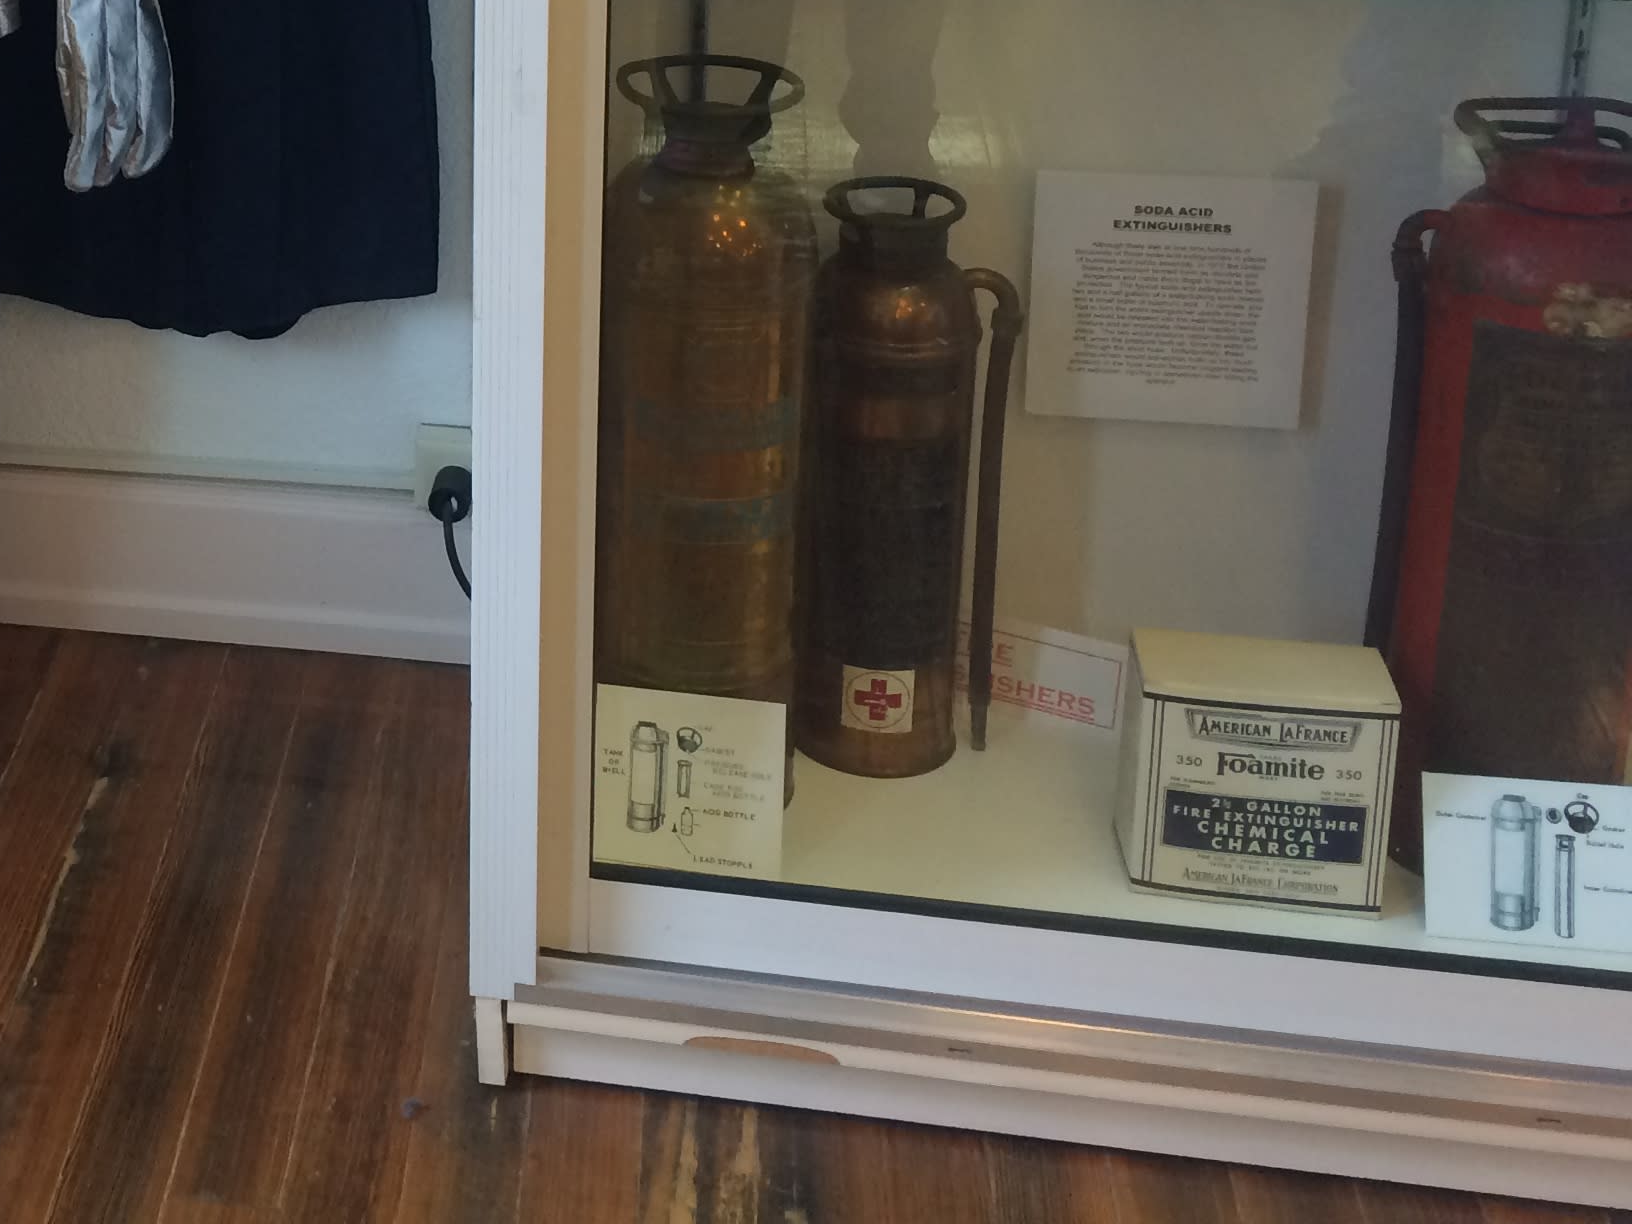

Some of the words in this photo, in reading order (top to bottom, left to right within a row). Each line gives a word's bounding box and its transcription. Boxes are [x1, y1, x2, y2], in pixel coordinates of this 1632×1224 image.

[1134, 205, 1174, 216] SODA
[1179, 207, 1214, 217] ACID
[1112, 219, 1232, 234] EXTINGUISHERS
[1198, 715, 1272, 737] AMERICAN
[1175, 754, 1203, 767] 350
[1216, 751, 1325, 781] Foamite
[1335, 769, 1363, 781] 350
[723, 810, 757, 821] BOTTLE
[1172, 804, 1212, 819] FIRE
[1223, 811, 1360, 833] EXTINGUISHER
[1246, 801, 1322, 818] GALLON
[1196, 820, 1329, 846] CHEMICAL
[1211, 837, 1317, 859] CHARGE
